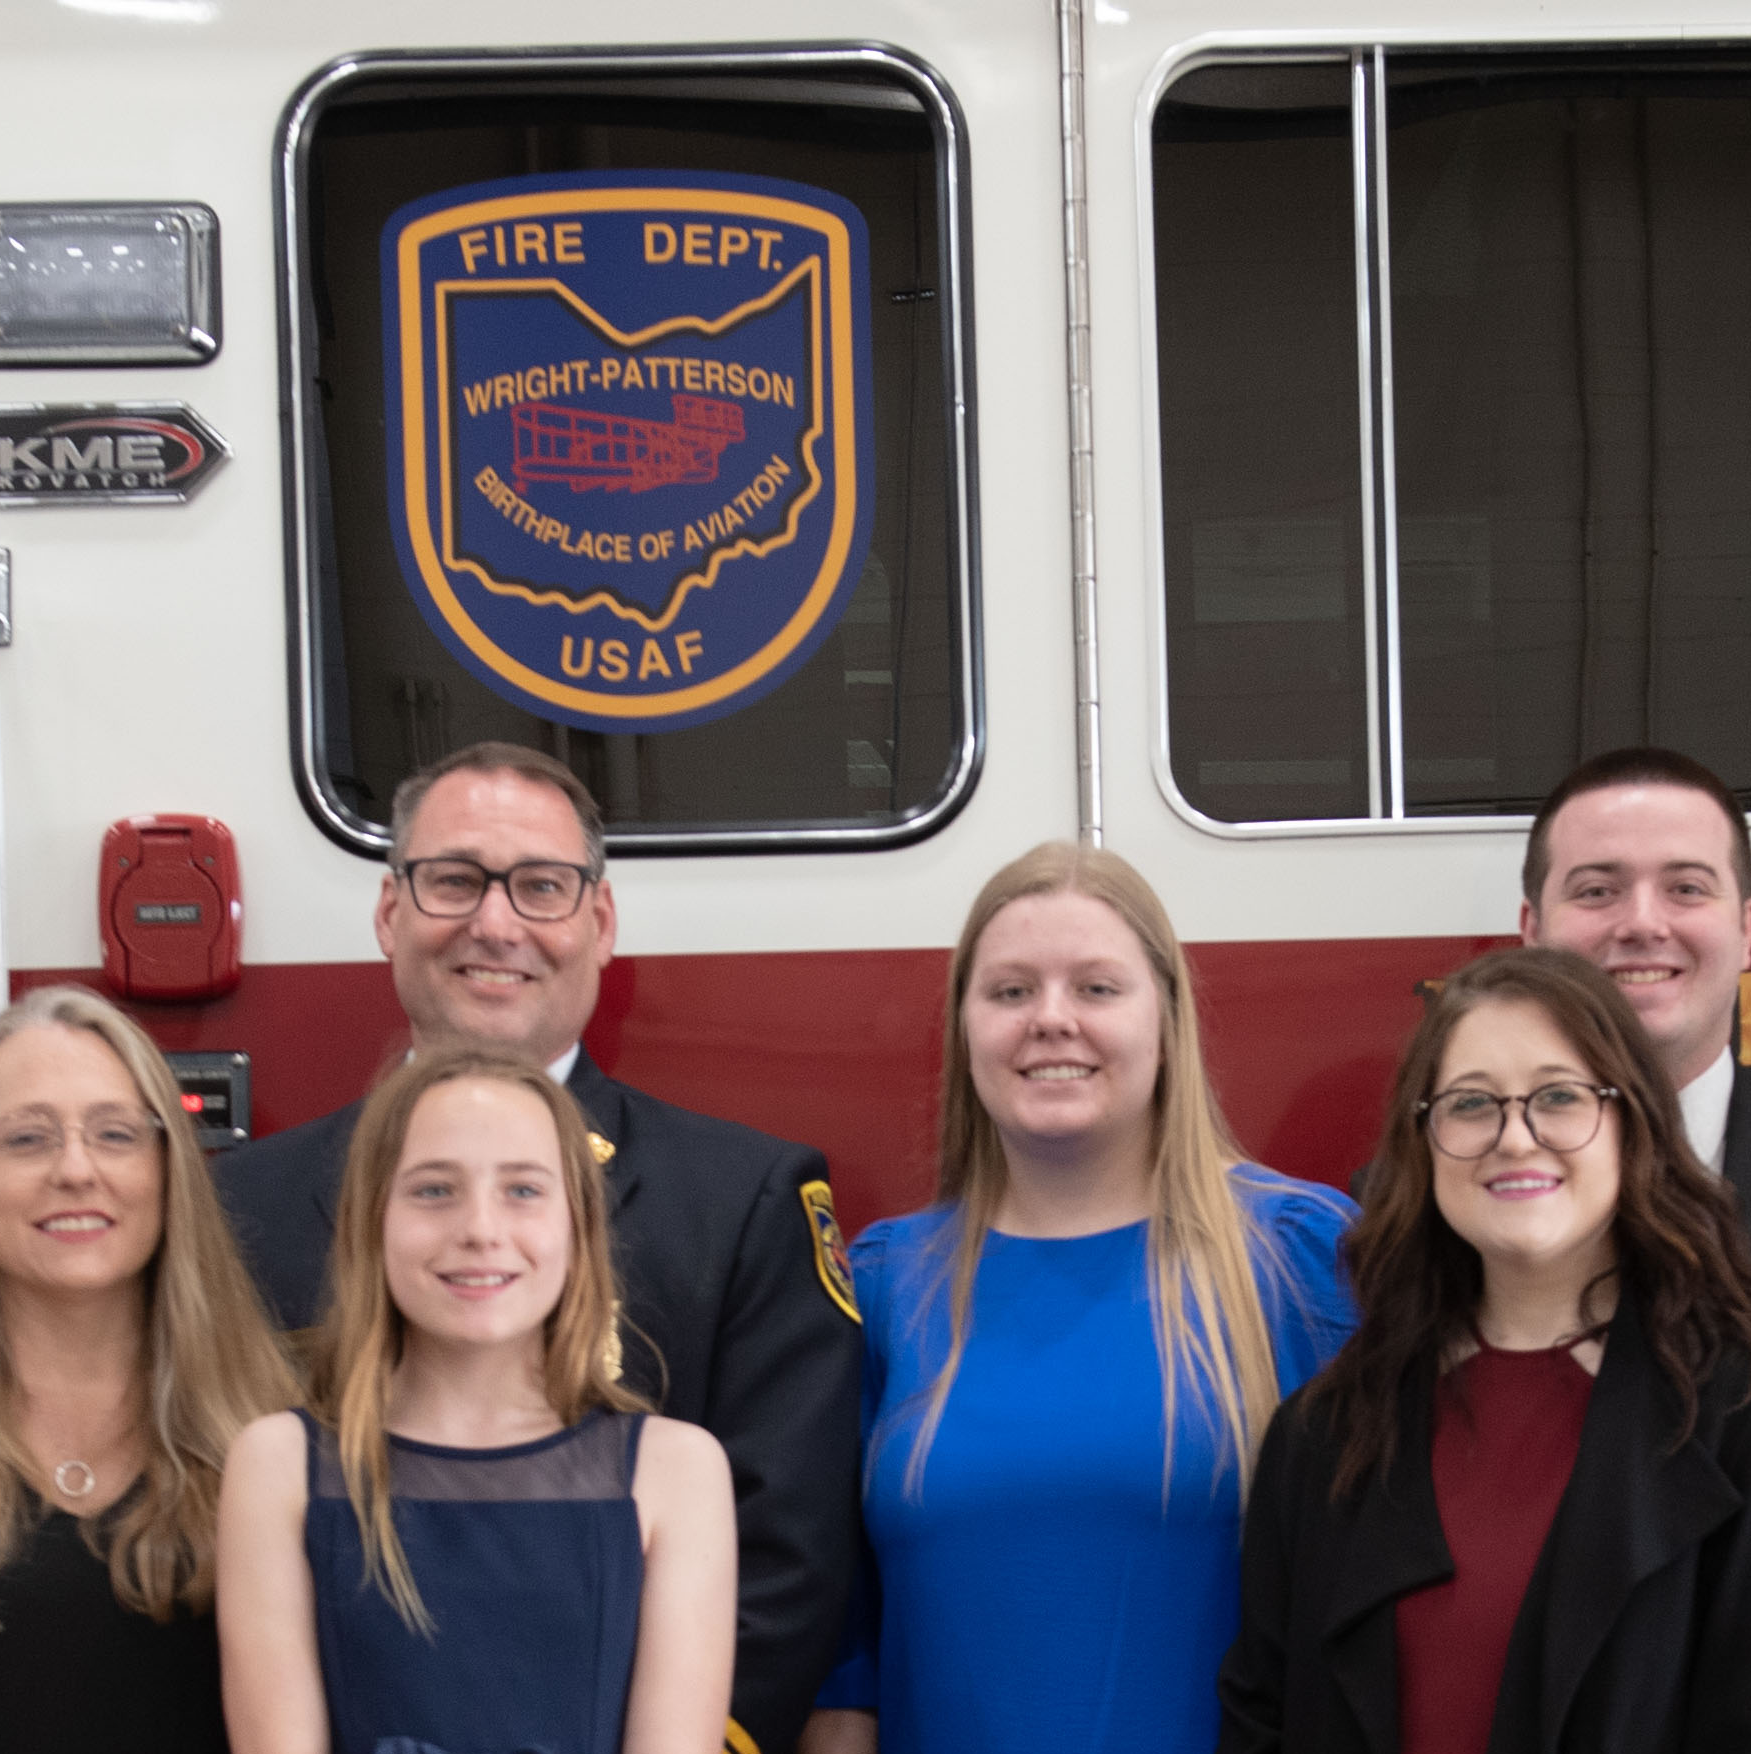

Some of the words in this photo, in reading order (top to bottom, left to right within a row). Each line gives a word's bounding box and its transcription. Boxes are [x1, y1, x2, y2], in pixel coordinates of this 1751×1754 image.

[458, 222, 585, 274] FIRE
[643, 222, 784, 272] DEPT.
[463, 356, 795, 417] WRIGHT-PATTERSON
[474, 465, 632, 562] BIRTHPLACE
[639, 530, 675, 561] OF
[684, 453, 792, 551] AVIATION
[560, 630, 704, 682] USAF
